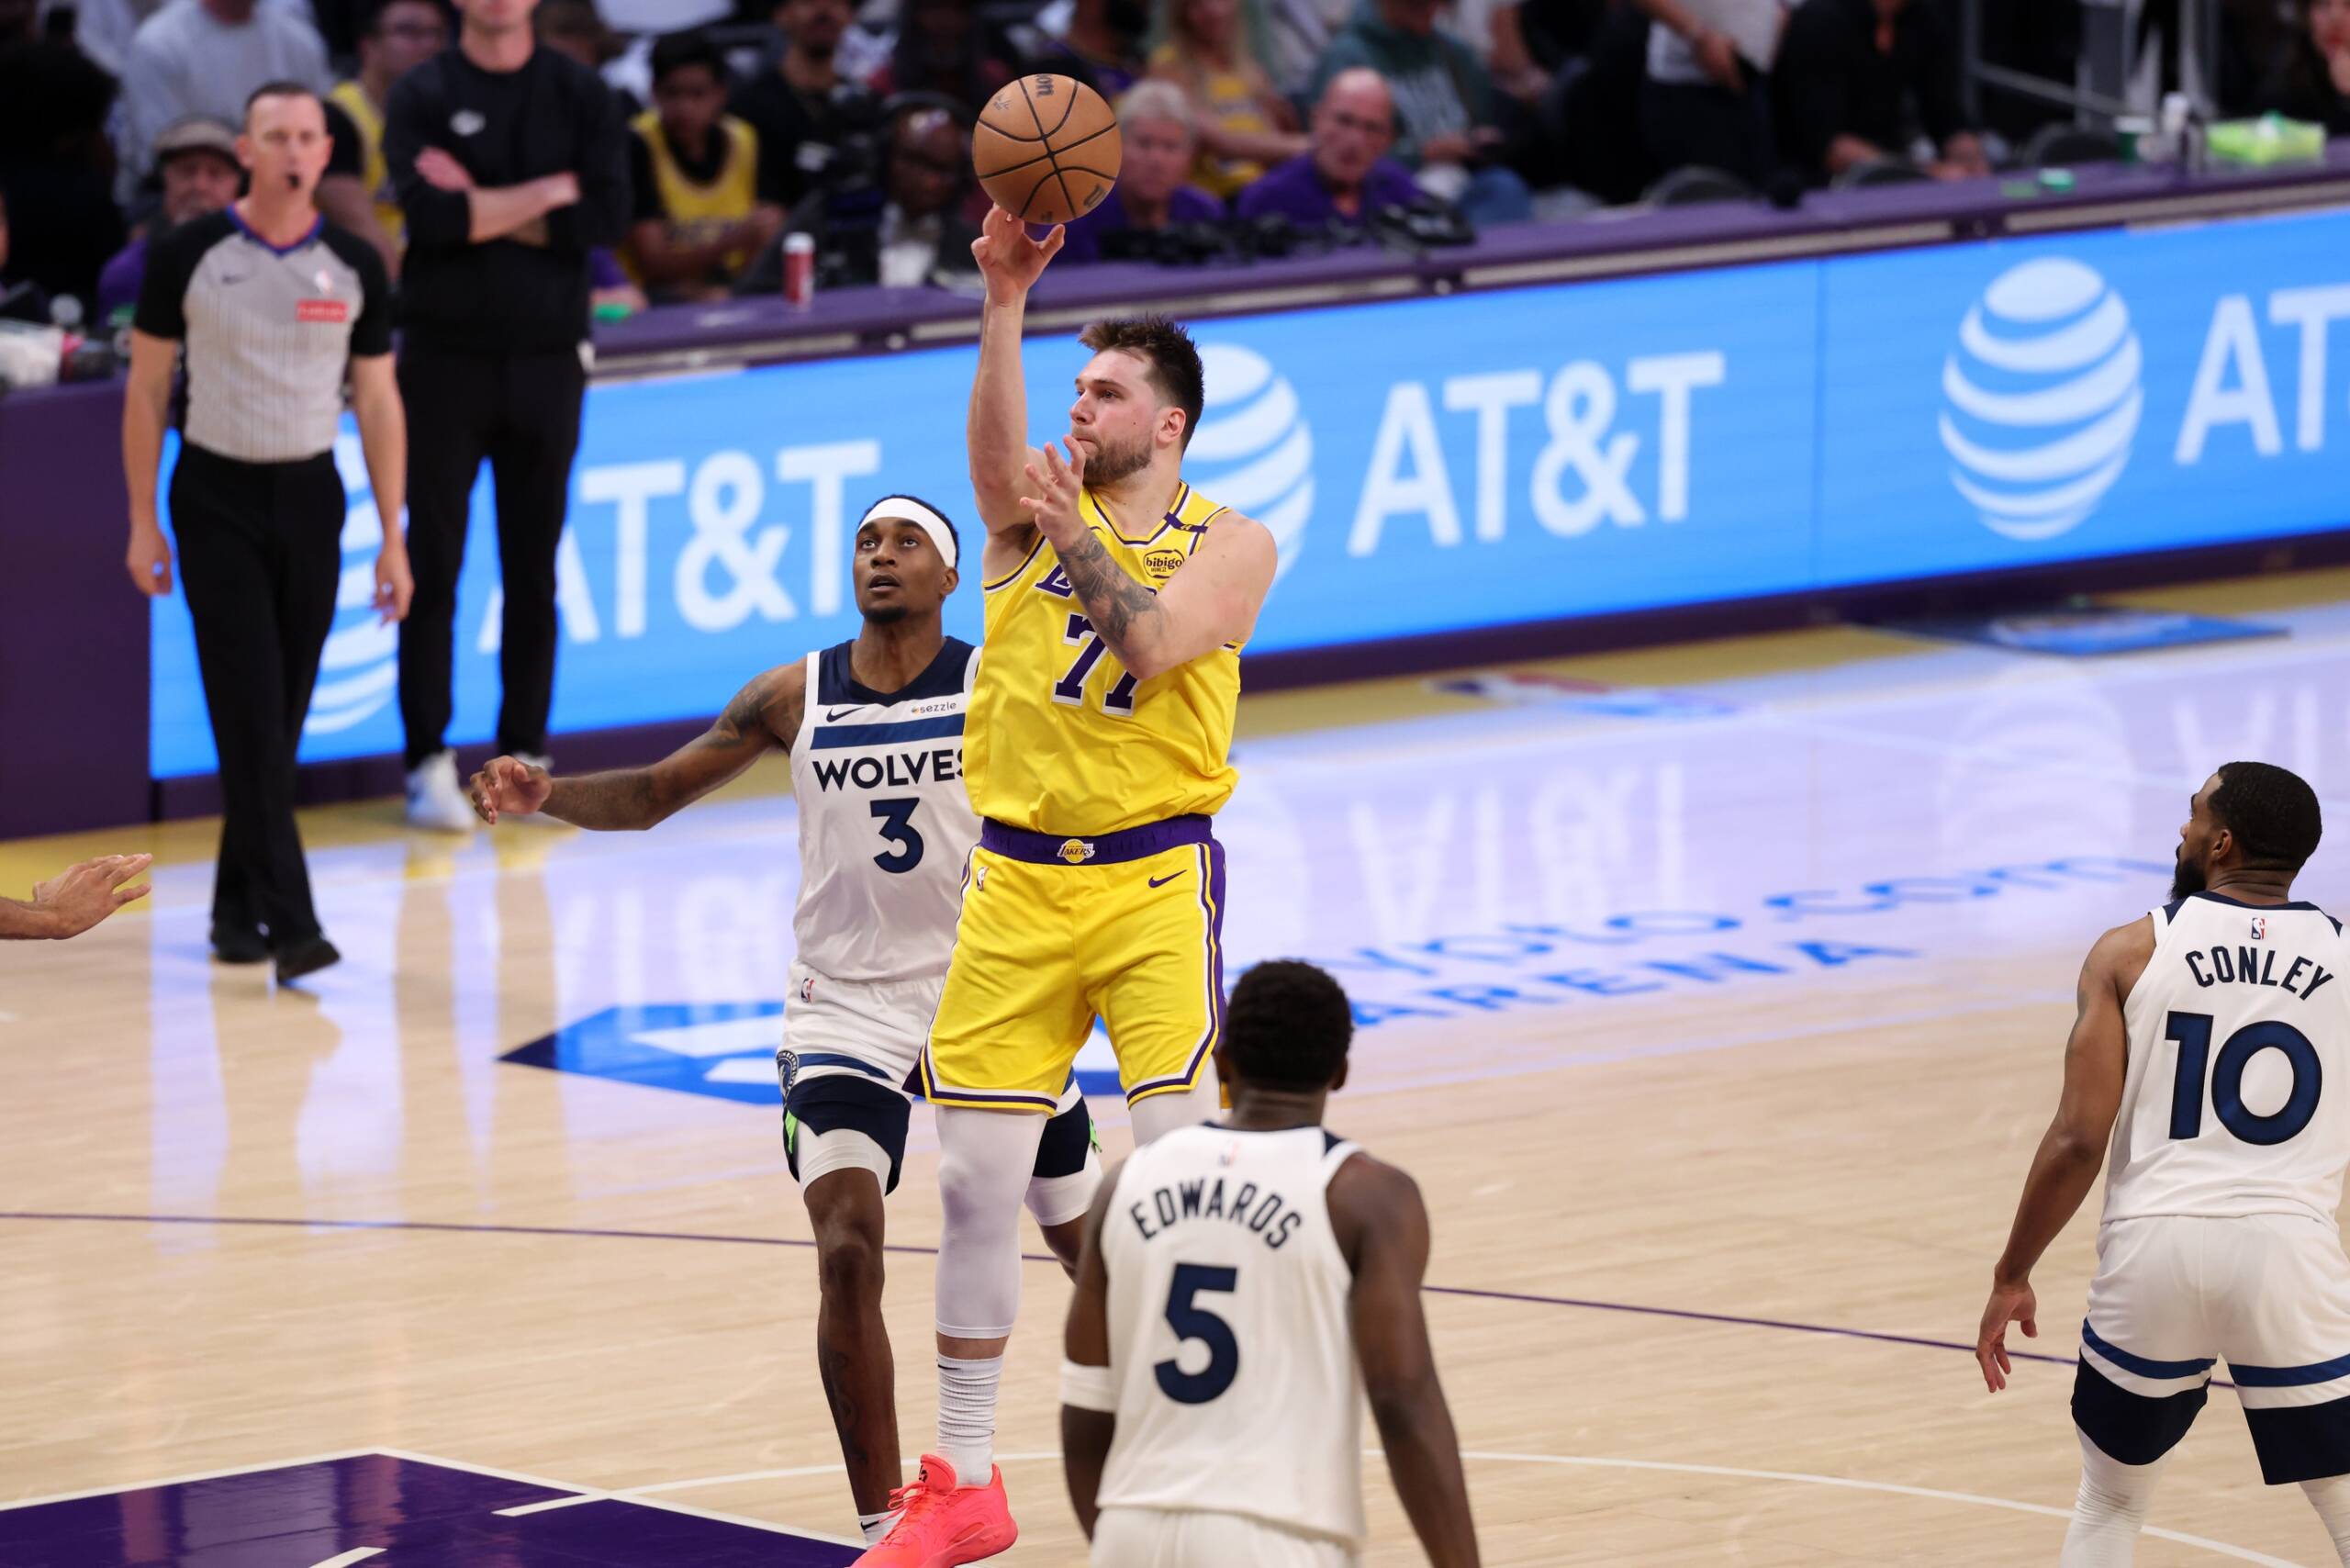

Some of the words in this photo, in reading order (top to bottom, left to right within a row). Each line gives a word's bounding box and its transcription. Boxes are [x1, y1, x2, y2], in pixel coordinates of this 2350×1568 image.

[2174, 283, 2350, 465] AT
[1346, 351, 1726, 558] AT&T
[1146, 556, 1183, 570] bibigo
[920, 702, 957, 713] sezzle
[869, 797, 924, 875] 3
[2185, 946, 2334, 1001] CONLEY
[2165, 1010, 2322, 1146] 10
[1130, 1178, 1302, 1249] EDWARDS
[1154, 1261, 1239, 1405] 5
